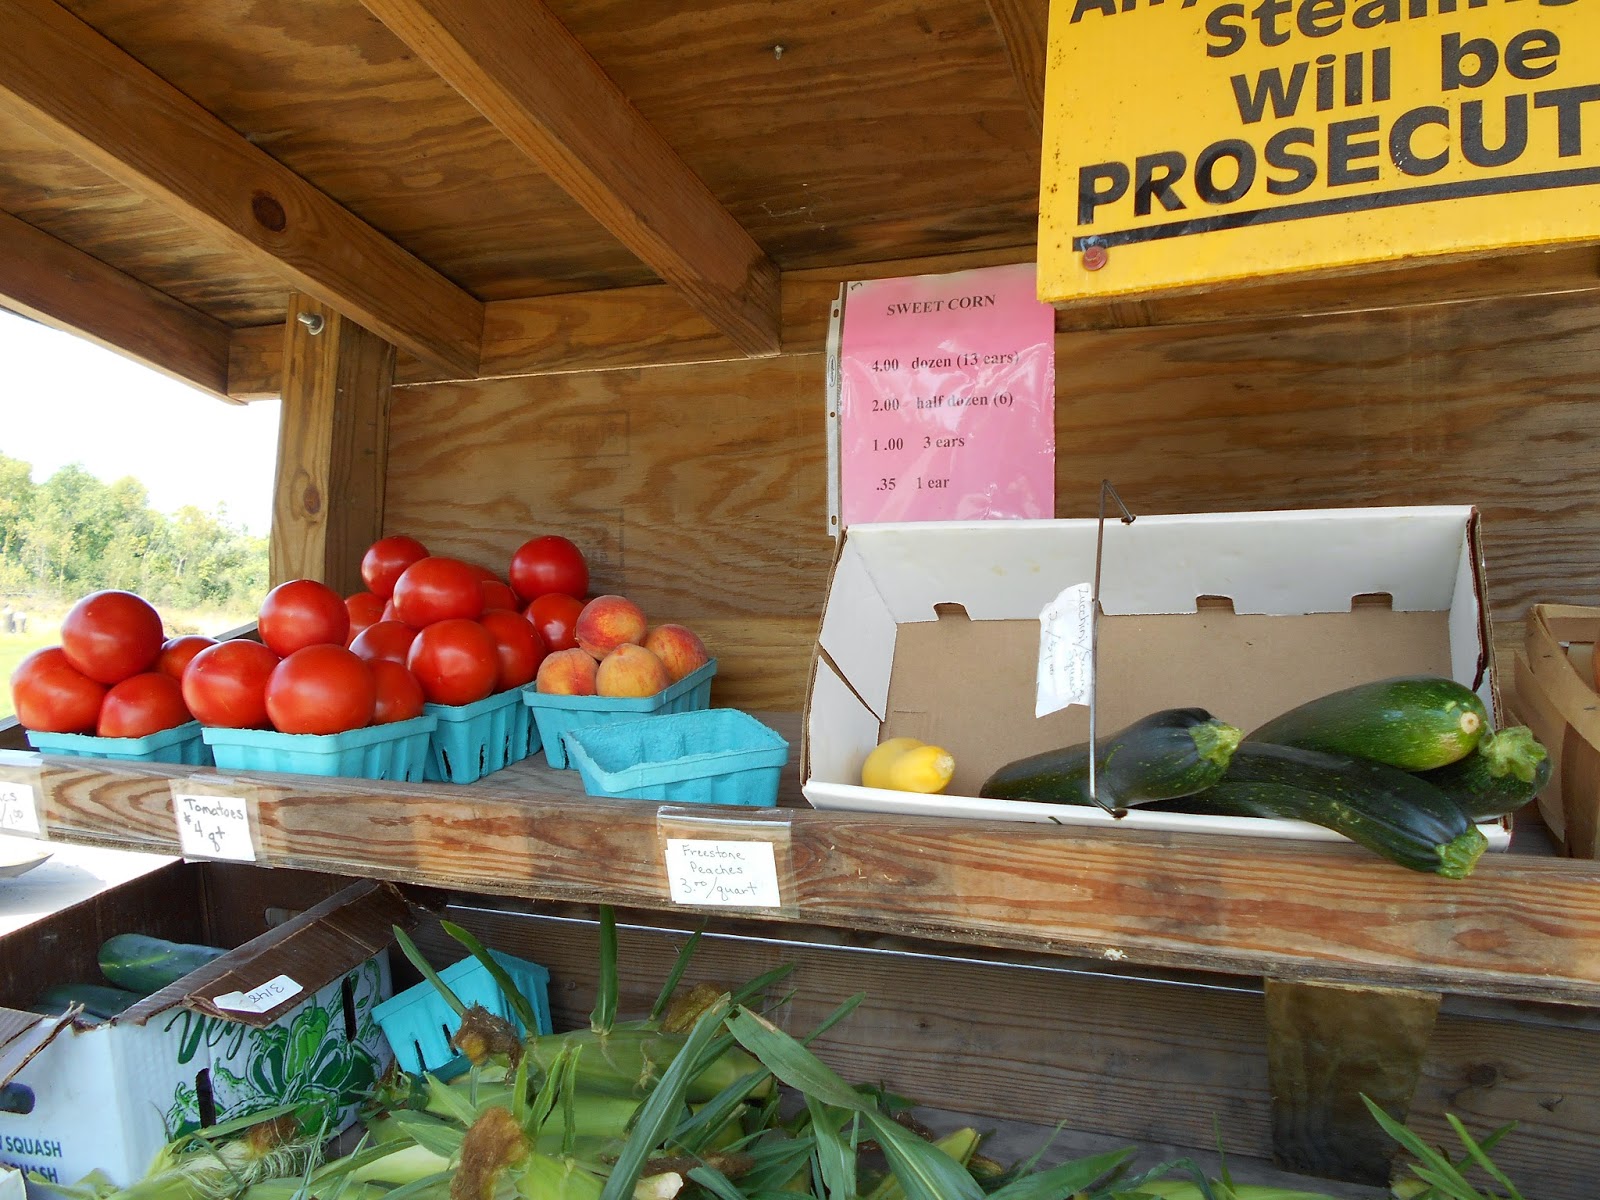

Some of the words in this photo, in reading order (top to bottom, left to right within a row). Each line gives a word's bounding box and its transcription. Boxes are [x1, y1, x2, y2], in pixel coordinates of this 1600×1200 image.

[1205, 0, 1579, 58] stea
[1441, 28, 1561, 91] be
[1077, 83, 1600, 226] PROSECUT
[886, 300, 945, 316] SWEET
[948, 295, 996, 311] CORN
[872, 358, 899, 372] 4.00
[911, 355, 951, 370] dozen
[956, 352, 979, 368] (13
[983, 350, 1020, 365] ears)
[872, 399, 900, 412] 2.00
[916, 395, 944, 410] half
[947, 394, 988, 408] dozen
[993, 392, 1013, 408] (6)
[923, 436, 931, 449] 3
[936, 437, 965, 449] ears
[876, 477, 896, 491] .35
[917, 477, 922, 489] 1
[928, 477, 950, 489] ear
[184, 798, 244, 820] Tomatoes
[682, 844, 746, 861] Freestone
[690, 861, 743, 875] Peaches
[248, 984, 285, 1004] 3148
[5, 1135, 63, 1158] SQUASH
